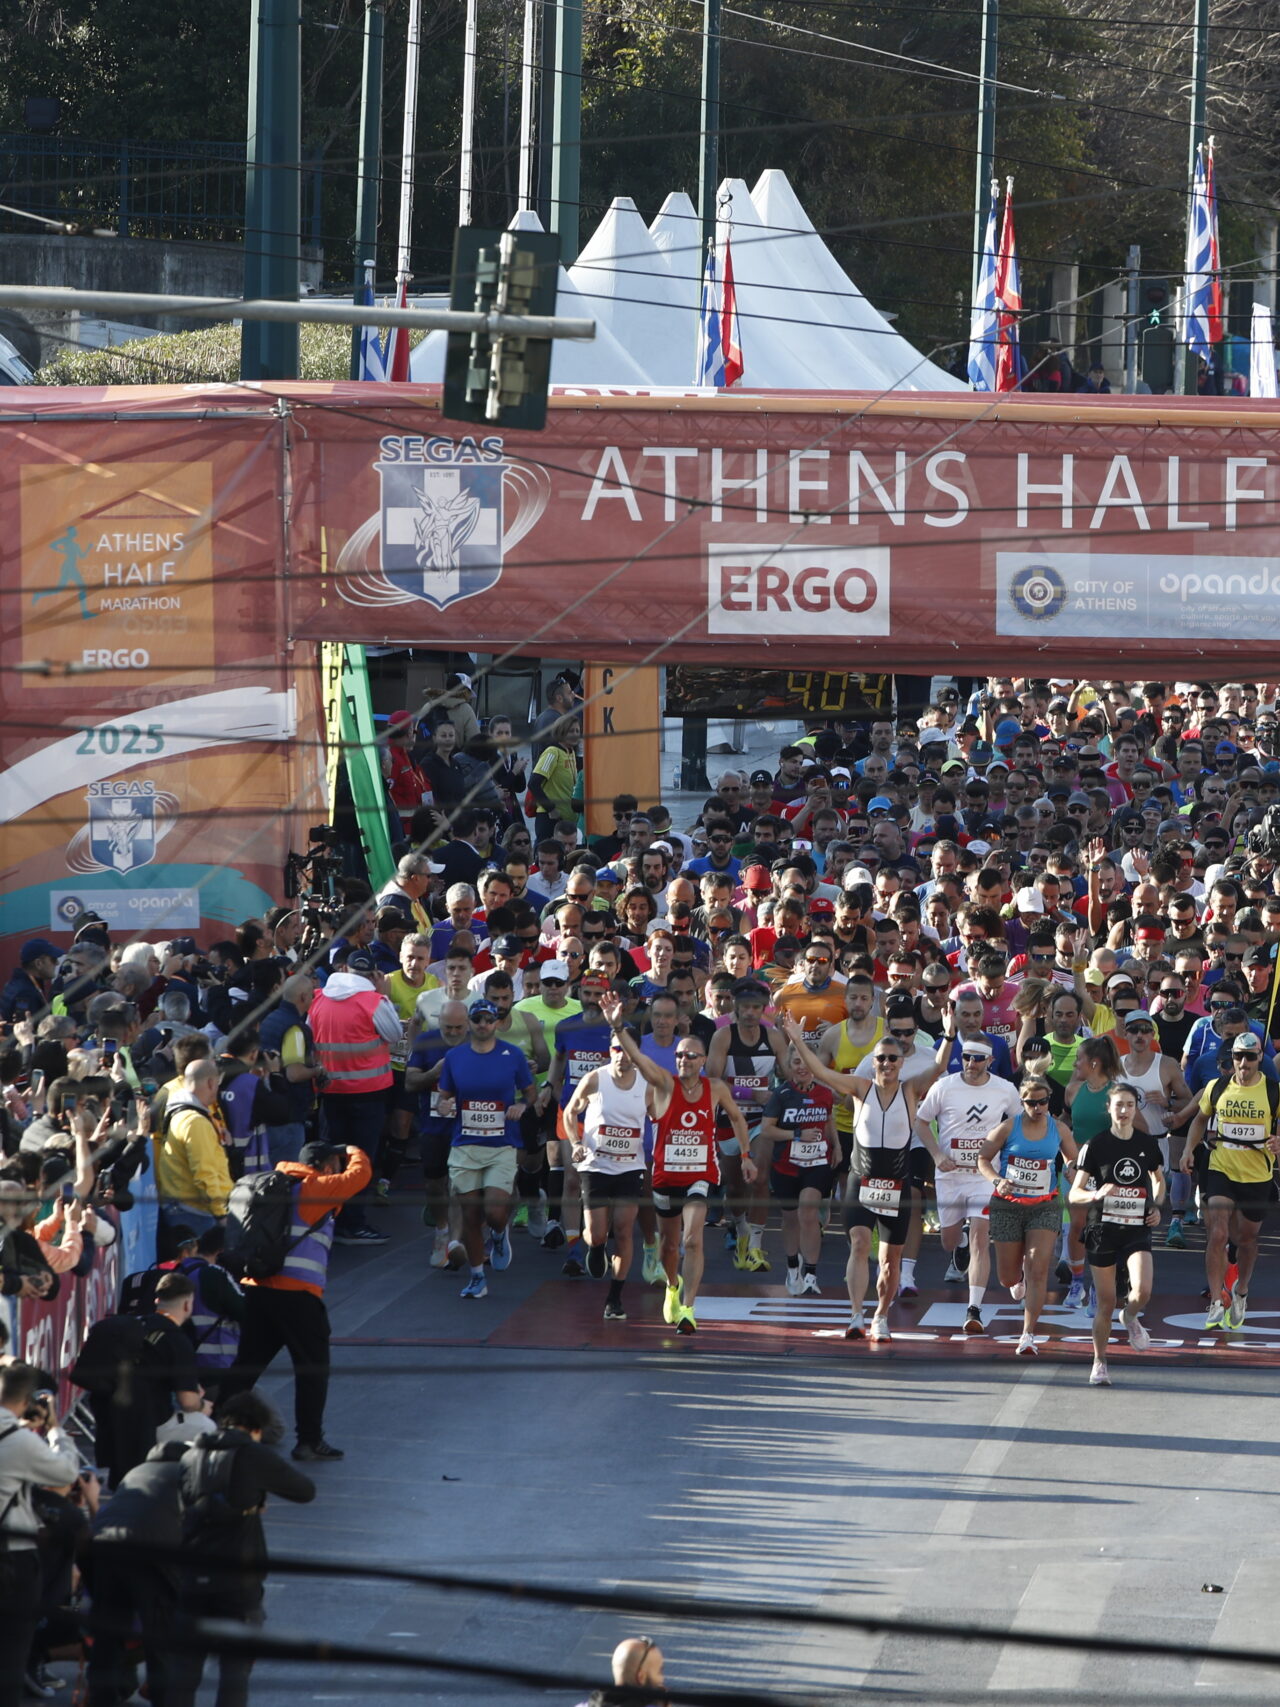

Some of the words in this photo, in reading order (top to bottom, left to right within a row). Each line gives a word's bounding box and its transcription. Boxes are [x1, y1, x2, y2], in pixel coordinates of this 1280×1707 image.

[380, 436, 504, 463] SEGAS
[581, 445, 970, 528] ATHENS
[1016, 453, 1268, 532] HALF
[96, 532, 185, 552] ATHENS
[104, 562, 175, 586] HALF
[720, 565, 878, 613] ERGO
[1074, 581, 1108, 594] CITY
[1112, 582, 1134, 594] OF
[100, 597, 181, 610] MARATHON
[1074, 598, 1137, 611] ATHENS
[82, 648, 150, 668] ERGO
[75, 723, 165, 755] 2025
[88, 781, 154, 796] SEGAS
[986, 1025, 1011, 1034] ERGO
[575, 1052, 602, 1061] ERGO
[734, 1077, 761, 1087] ERGO
[469, 1101, 497, 1111] ERGO
[1226, 1100, 1255, 1110] PACE
[470, 1113, 496, 1123] 4895
[1220, 1109, 1265, 1119] RUNNER
[605, 1127, 633, 1137] ERGO
[1231, 1126, 1255, 1136] 4973
[605, 1139, 631, 1149] 4080
[672, 1135, 701, 1145] ERGO
[673, 1148, 698, 1158] 4435
[1013, 1157, 1041, 1169] ERGO
[1013, 1169, 1038, 1182] 3962
[867, 1179, 895, 1189] ERGO
[868, 1192, 892, 1202] 4143
[1113, 1187, 1140, 1197] RGO
[1113, 1199, 1137, 1210] 3206
